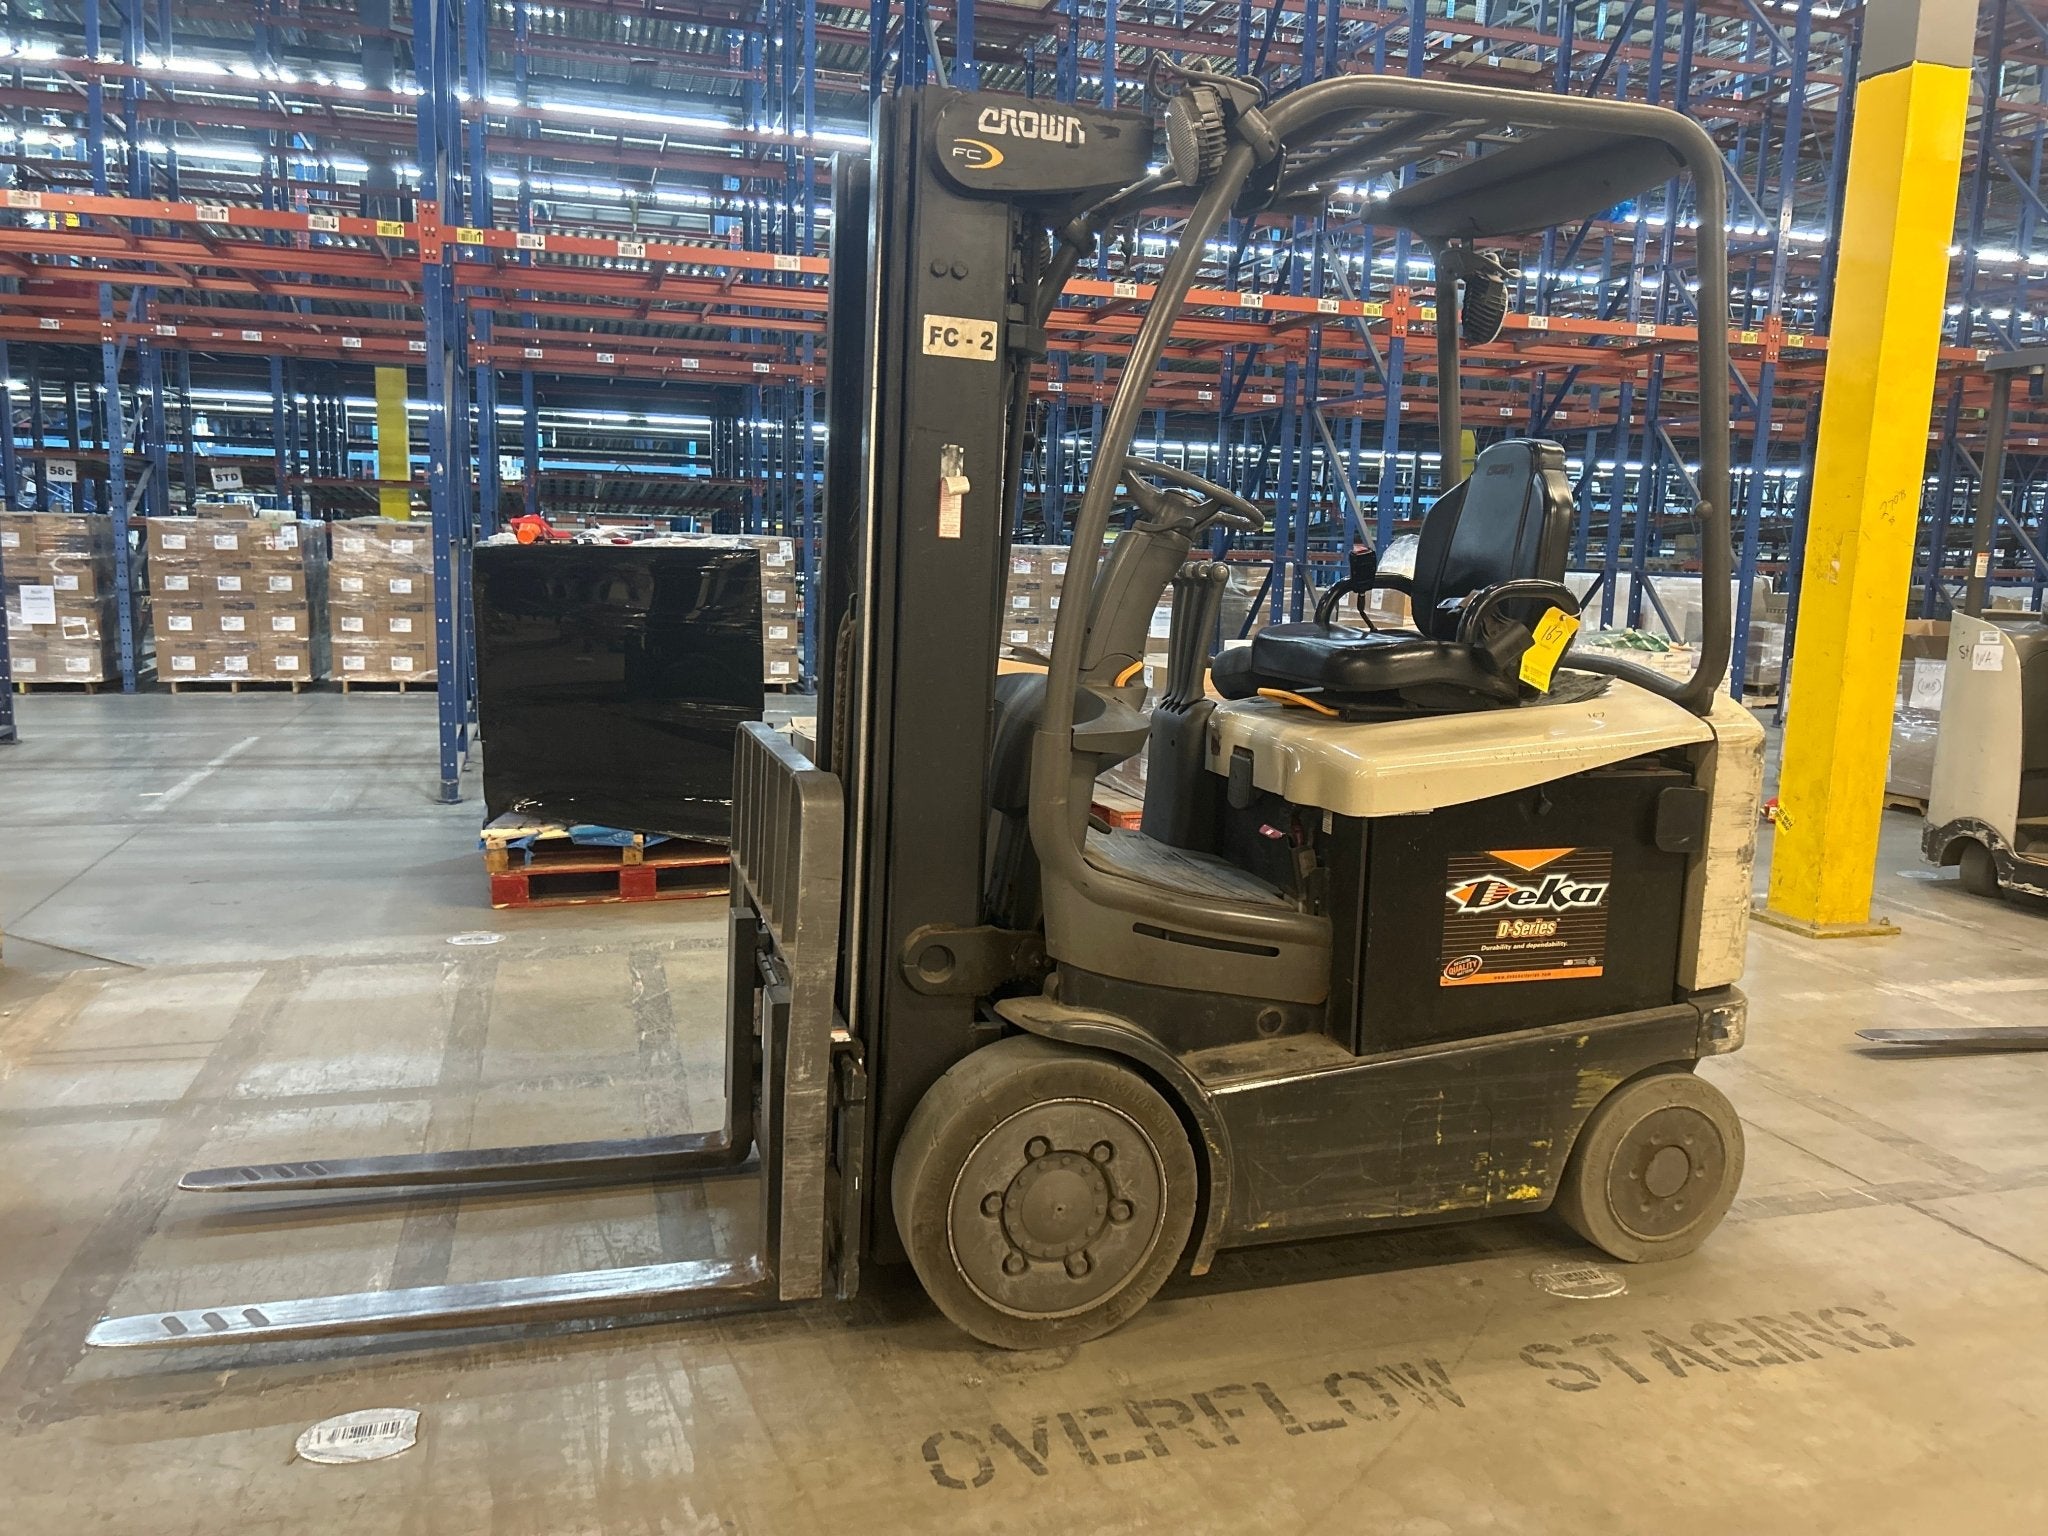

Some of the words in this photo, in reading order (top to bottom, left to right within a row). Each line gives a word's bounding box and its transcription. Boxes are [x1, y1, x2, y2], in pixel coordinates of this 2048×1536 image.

[978, 106, 1086, 144] CROWN
[952, 147, 982, 161] FC
[929, 325, 959, 347] FC
[980, 331, 994, 351] 2
[49, 466, 73, 477] 58c
[215, 473, 239, 482] STD
[1452, 875, 1608, 911] Deka
[1495, 918, 1558, 939] D-Series
[1480, 942, 1512, 952] Durability
[1512, 942, 1525, 950] and
[1448, 960, 1478, 975] QUALITY
[920, 1356, 1467, 1491] OVERFLOW
[1518, 1305, 1916, 1394] STAGING
